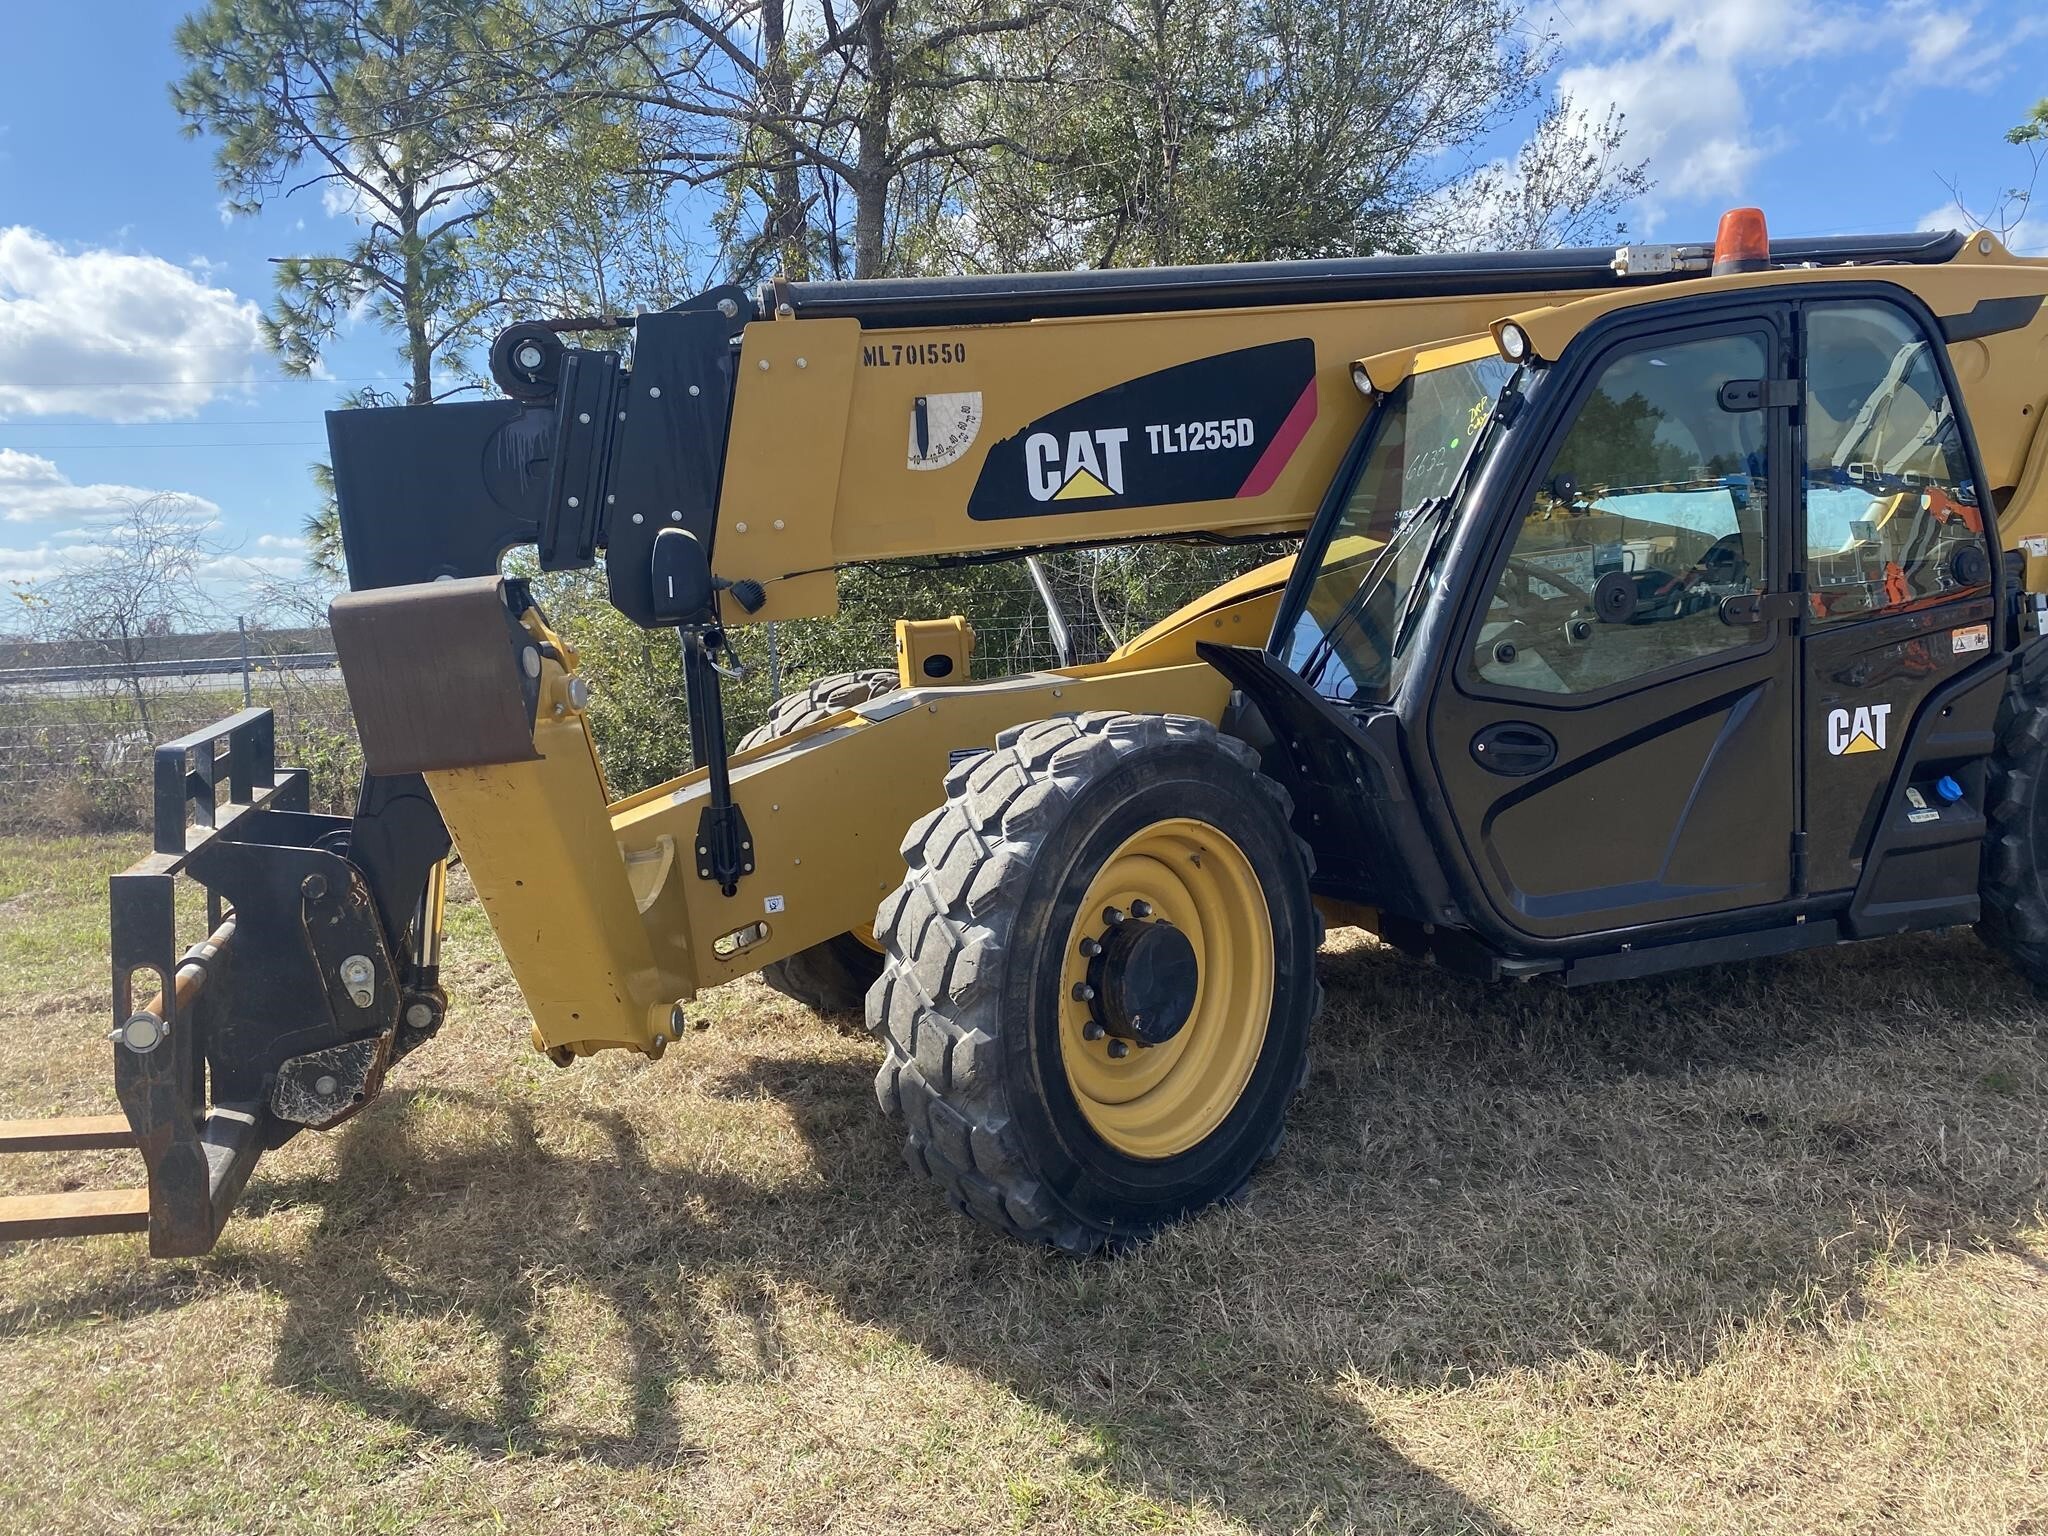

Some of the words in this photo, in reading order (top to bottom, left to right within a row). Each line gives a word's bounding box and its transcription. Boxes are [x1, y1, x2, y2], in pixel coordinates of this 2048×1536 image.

[1025, 428, 1129, 501] CAT
[1145, 418, 1255, 454] TL1255D
[1405, 447, 1446, 480] 6632
[1828, 703, 1892, 756] CAT
